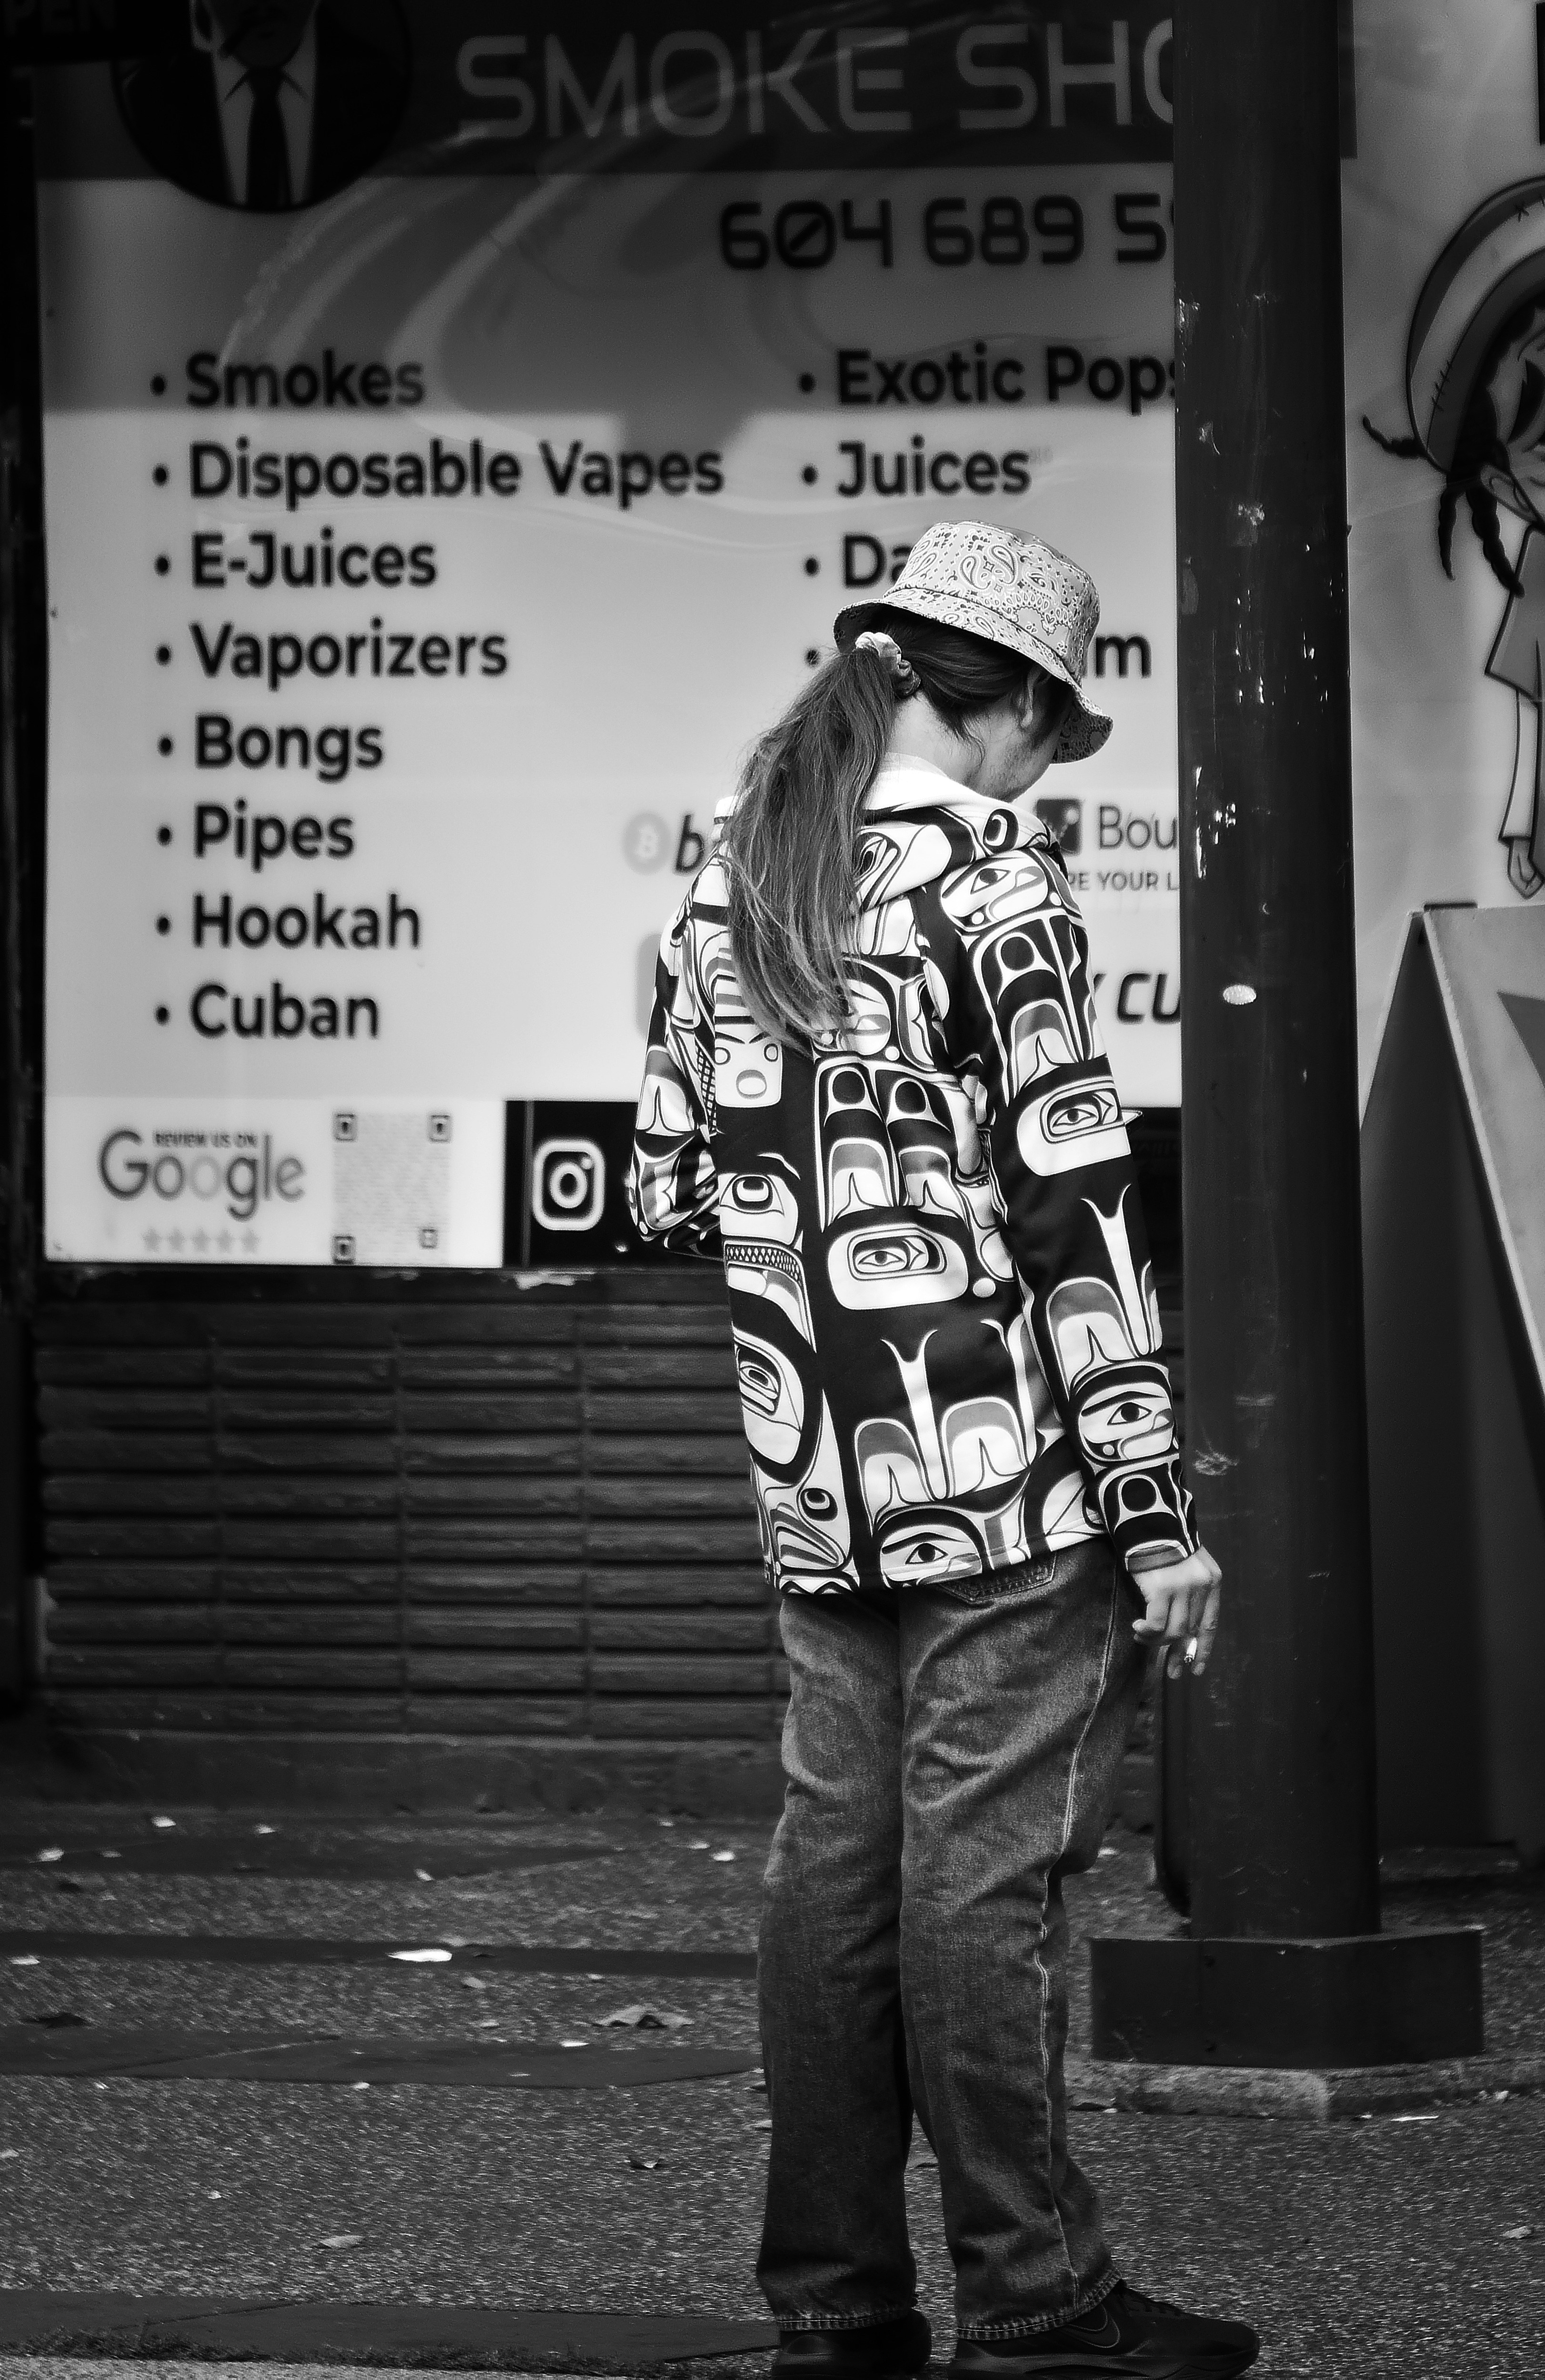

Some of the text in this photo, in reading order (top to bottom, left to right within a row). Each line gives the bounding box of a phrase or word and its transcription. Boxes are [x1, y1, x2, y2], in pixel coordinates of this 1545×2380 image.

[456, 27, 912, 138] SMOKE
[719, 193, 1173, 270] 604 689 5
[185, 349, 425, 406] Smokes
[835, 341, 1174, 416] Exotic Pop
[189, 435, 724, 513] Disposable Vapes
[838, 434, 1031, 498] Juices
[191, 525, 437, 589] E-Juices
[189, 616, 508, 693] Vaporizers
[195, 712, 383, 784] Bongs
[194, 797, 355, 873] Pipes
[1098, 871, 1159, 891] YOUR
[193, 891, 420, 948] Hookah
[190, 980, 379, 1038] Cuban
[97, 1127, 305, 1221] Google
